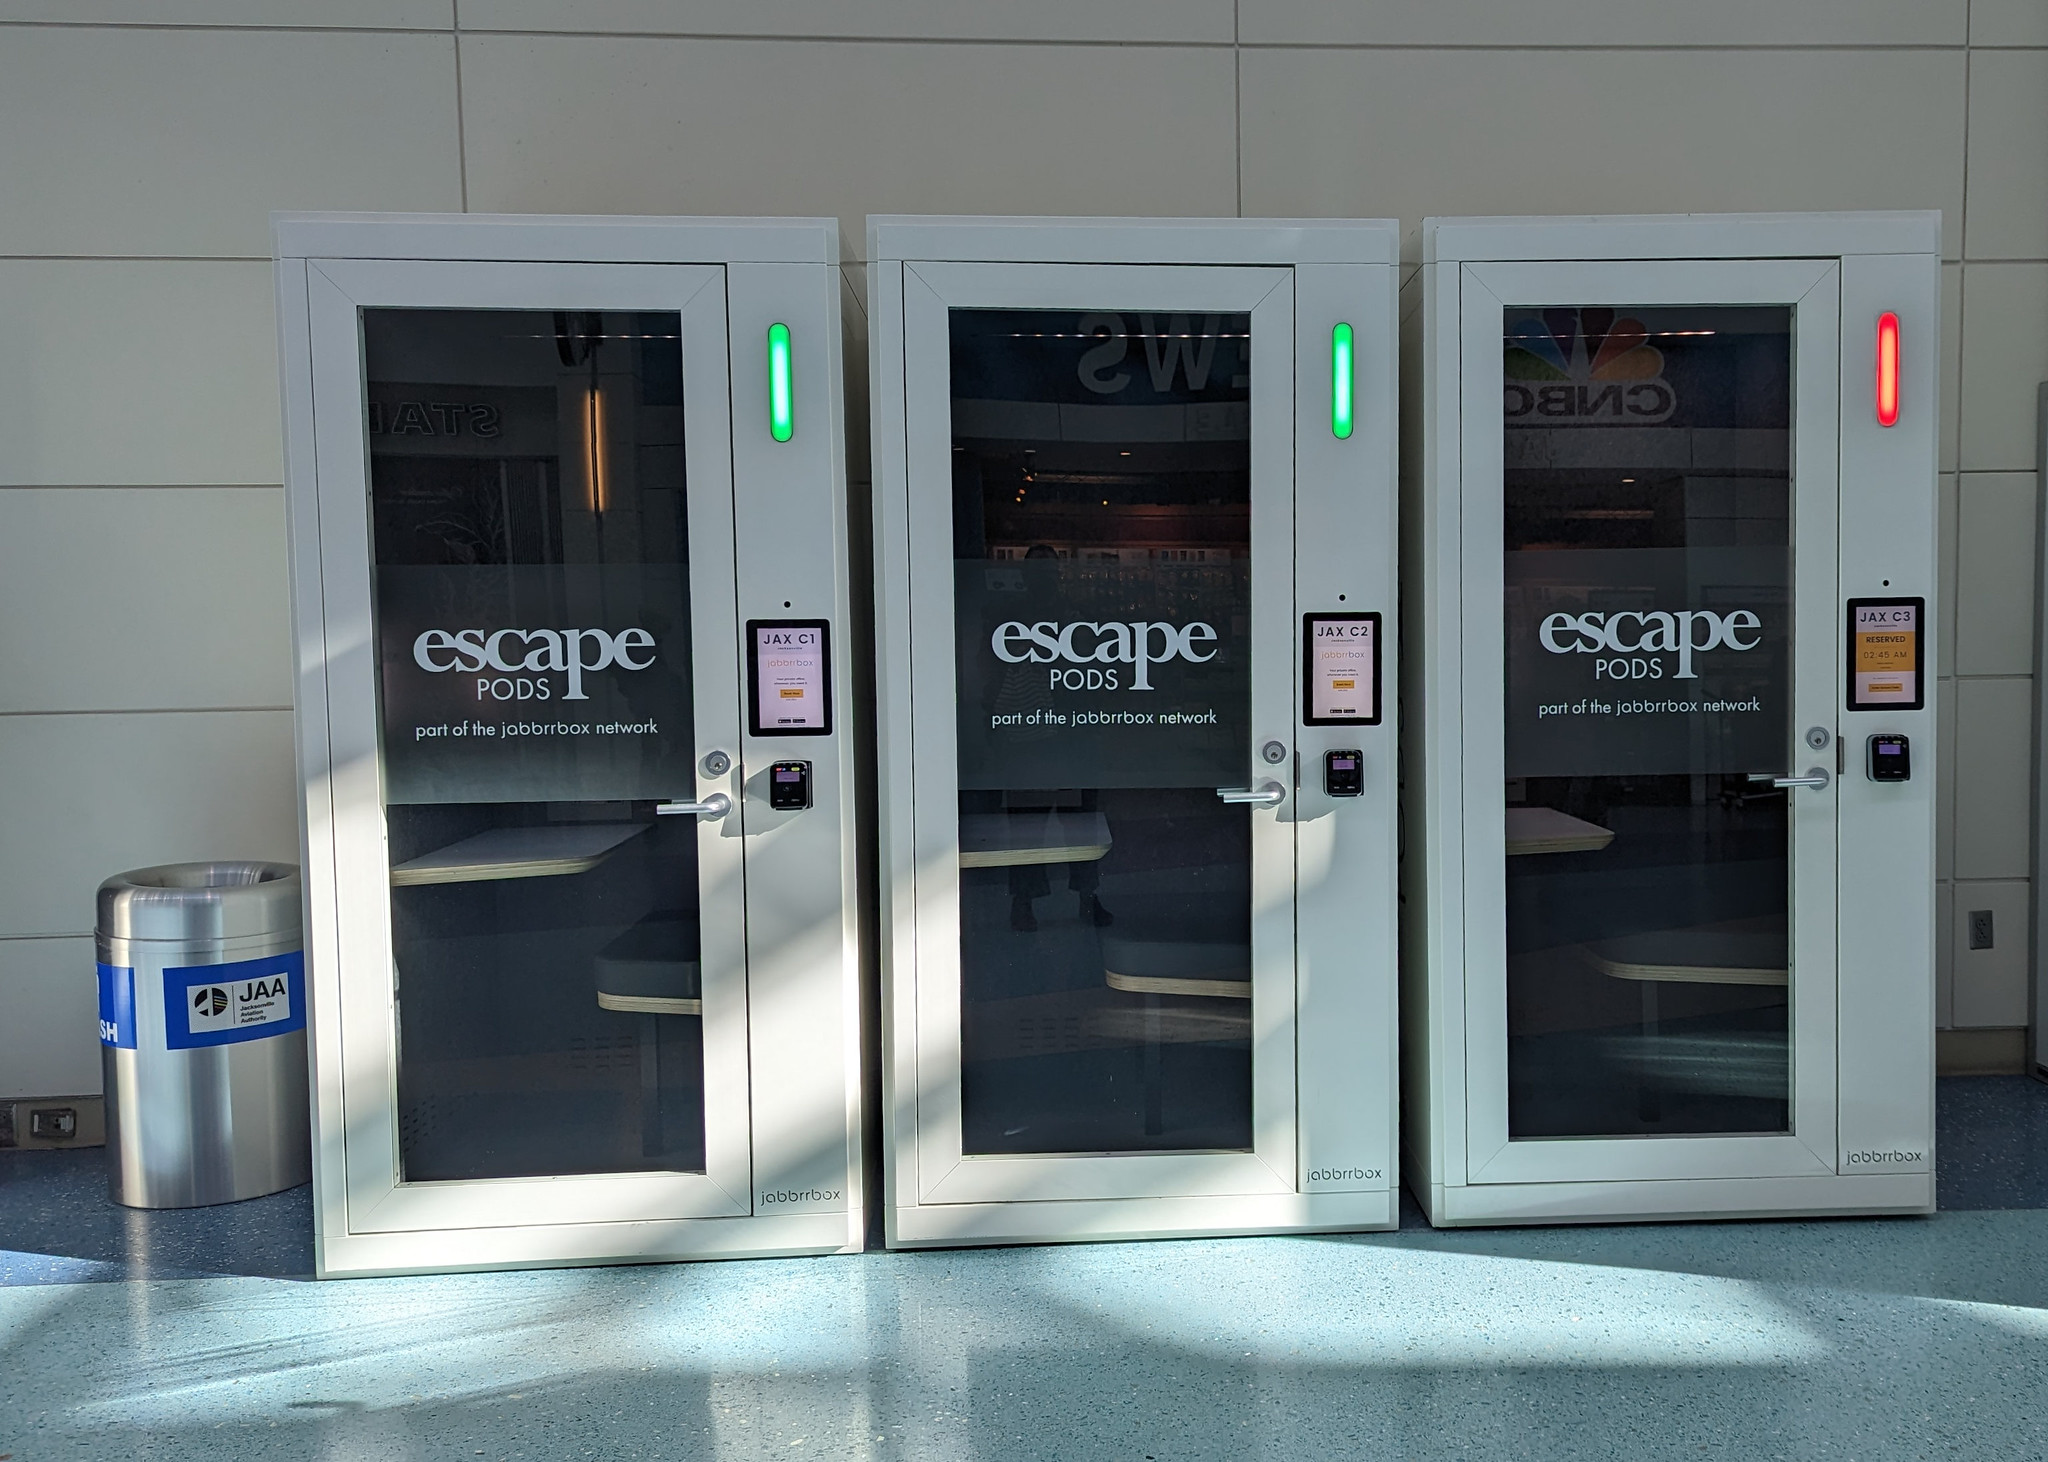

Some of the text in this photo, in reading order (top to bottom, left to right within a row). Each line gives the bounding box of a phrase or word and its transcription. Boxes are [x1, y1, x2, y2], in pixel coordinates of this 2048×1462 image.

[1860, 611, 1911, 623] JAX C3
[763, 633, 815, 645] JAX C1
[1317, 626, 1368, 637] JAX C2
[1866, 635, 1906, 644] RESERVED
[1539, 609, 1761, 679] escape
[413, 628, 656, 700] escape
[991, 621, 1218, 690] escape
[1863, 651, 1890, 659] 02:45
[1595, 657, 1663, 680] PODS
[1050, 668, 1119, 690] PODS
[477, 677, 550, 701] PODS
[1538, 696, 1761, 719] part of the jabbrrbox network
[991, 708, 1217, 729] part of the jabbrrbox network
[415, 718, 658, 741] part of the jabbrrbox network
[239, 977, 286, 1002] JAA
[239, 1001, 275, 1011] Jacksonville
[240, 1010, 264, 1018] Aviation
[240, 1015, 268, 1024] Authority
[1847, 1149, 1922, 1166] jabbrrbox
[1306, 1167, 1382, 1184] jabbrrbox
[760, 1188, 841, 1207] jabbrrbox
